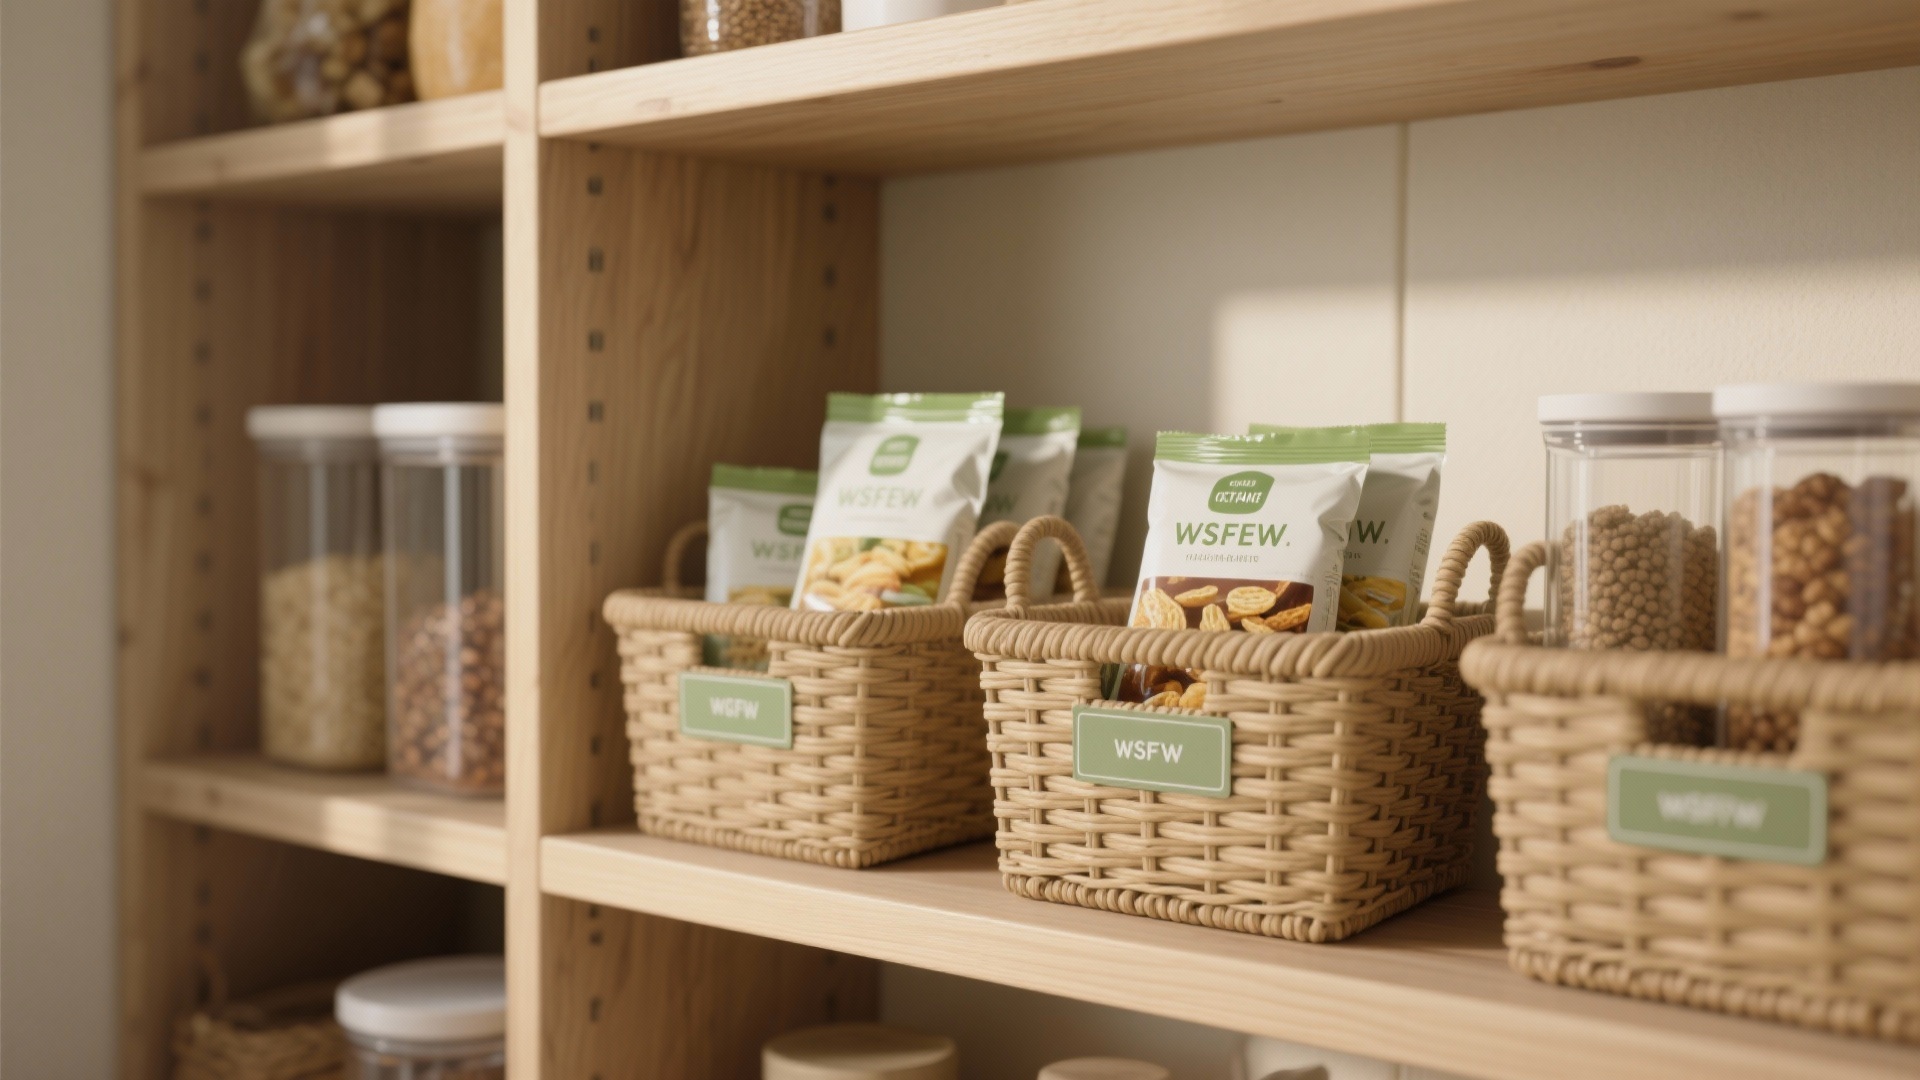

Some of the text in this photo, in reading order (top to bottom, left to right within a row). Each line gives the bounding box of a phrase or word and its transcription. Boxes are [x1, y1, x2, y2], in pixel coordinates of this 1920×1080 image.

[1349, 519, 1389, 544] W.
[751, 540, 806, 561] WSF
[1114, 738, 1184, 764] WSFW
